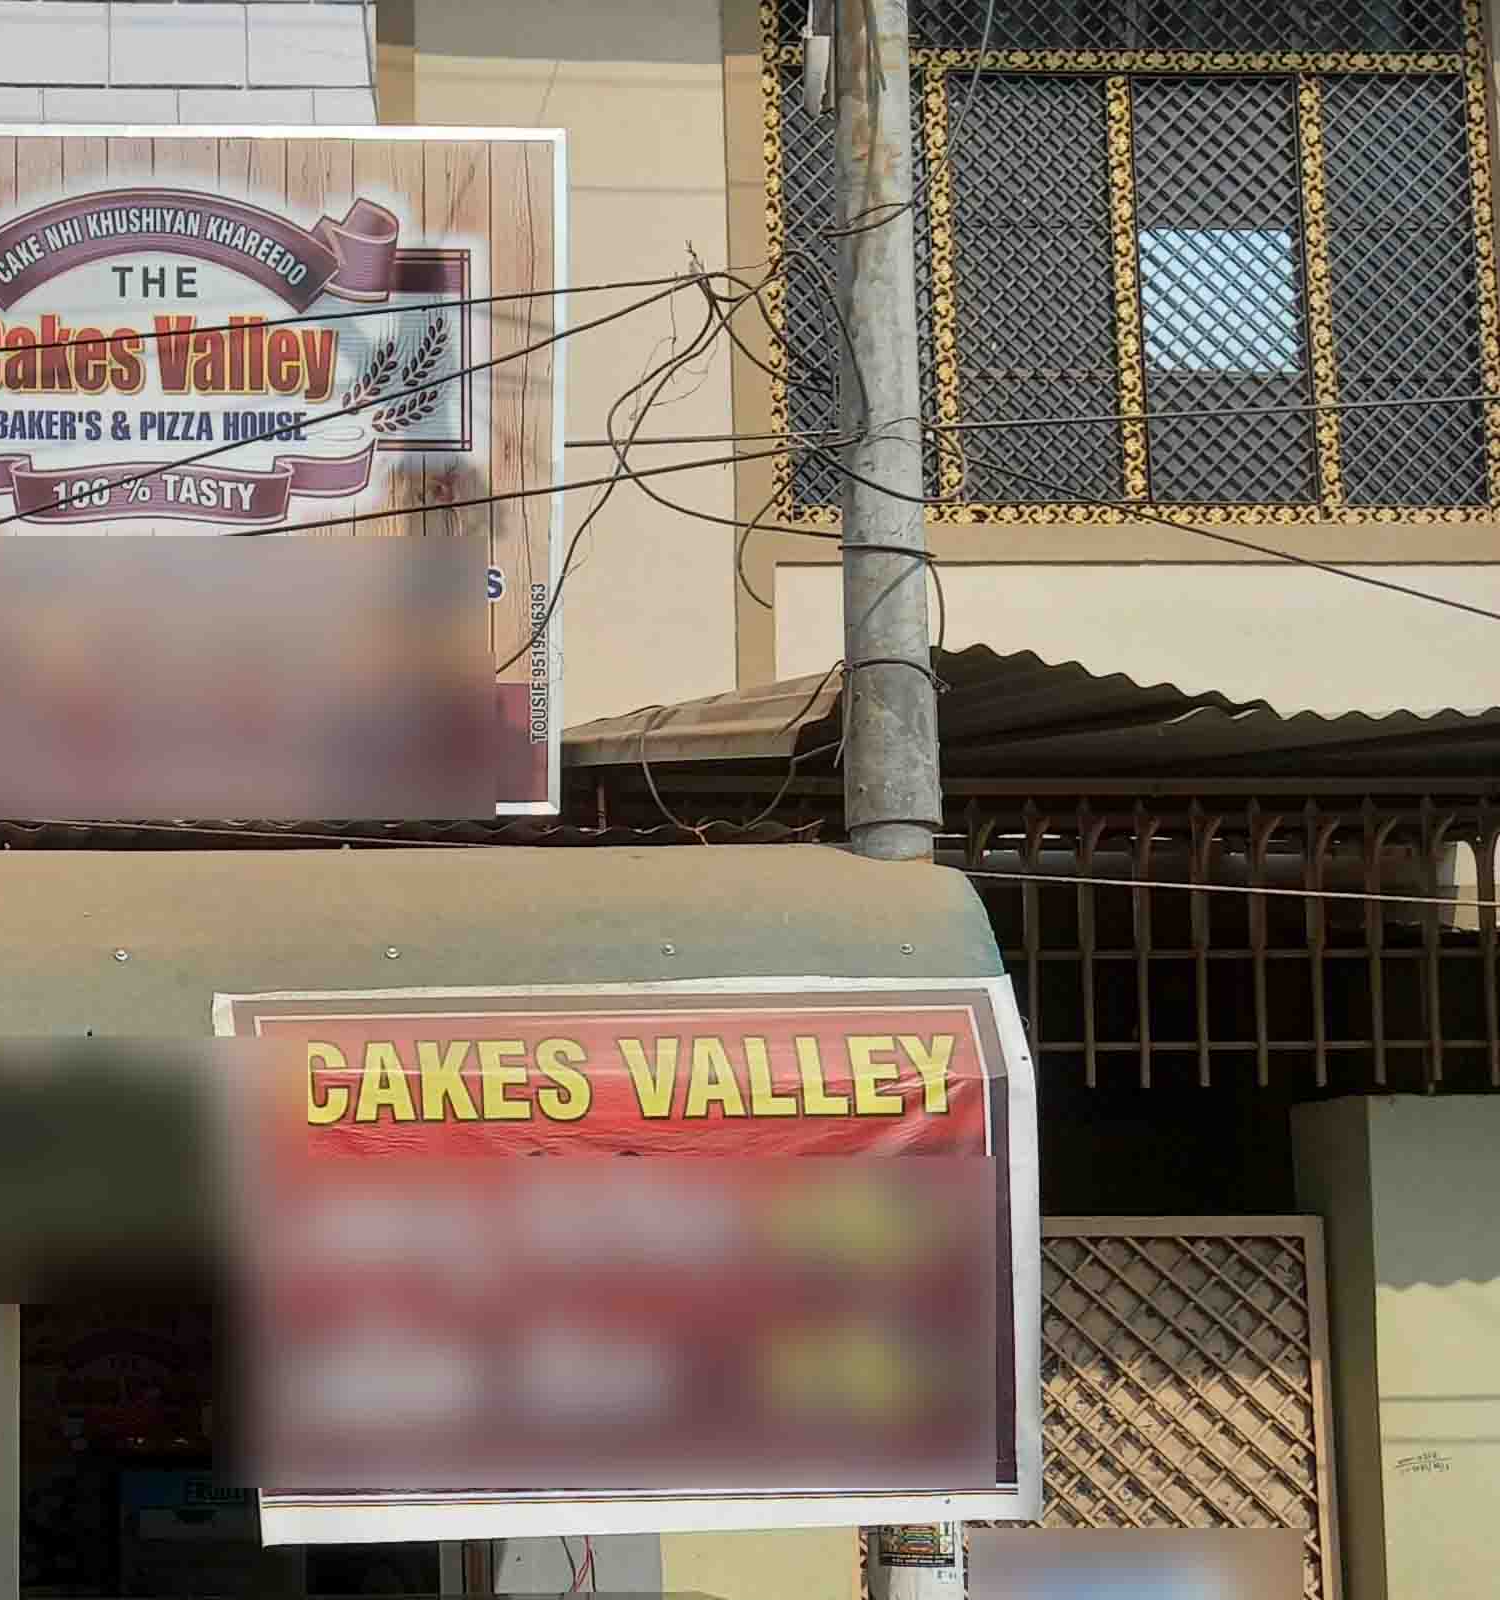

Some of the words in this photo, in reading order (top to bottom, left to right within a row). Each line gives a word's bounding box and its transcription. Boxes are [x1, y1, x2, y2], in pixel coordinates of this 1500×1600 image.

[45, 217, 82, 253] NHI
[86, 207, 200, 240] KHUSHIYAN
[206, 215, 308, 286] KHAREEDO
[111, 265, 198, 298] THE
[152, 311, 339, 404] Valley
[111, 411, 132, 441] &
[140, 410, 214, 441] PIZZA
[223, 410, 307, 441] HOUSE
[52, 477, 111, 511] 100
[122, 475, 150, 503] %
[161, 474, 257, 511] TASTY
[531, 681, 548, 743] TOUSIF
[307, 1035, 593, 1127] CAKES
[618, 1033, 957, 1120] VALLEY
